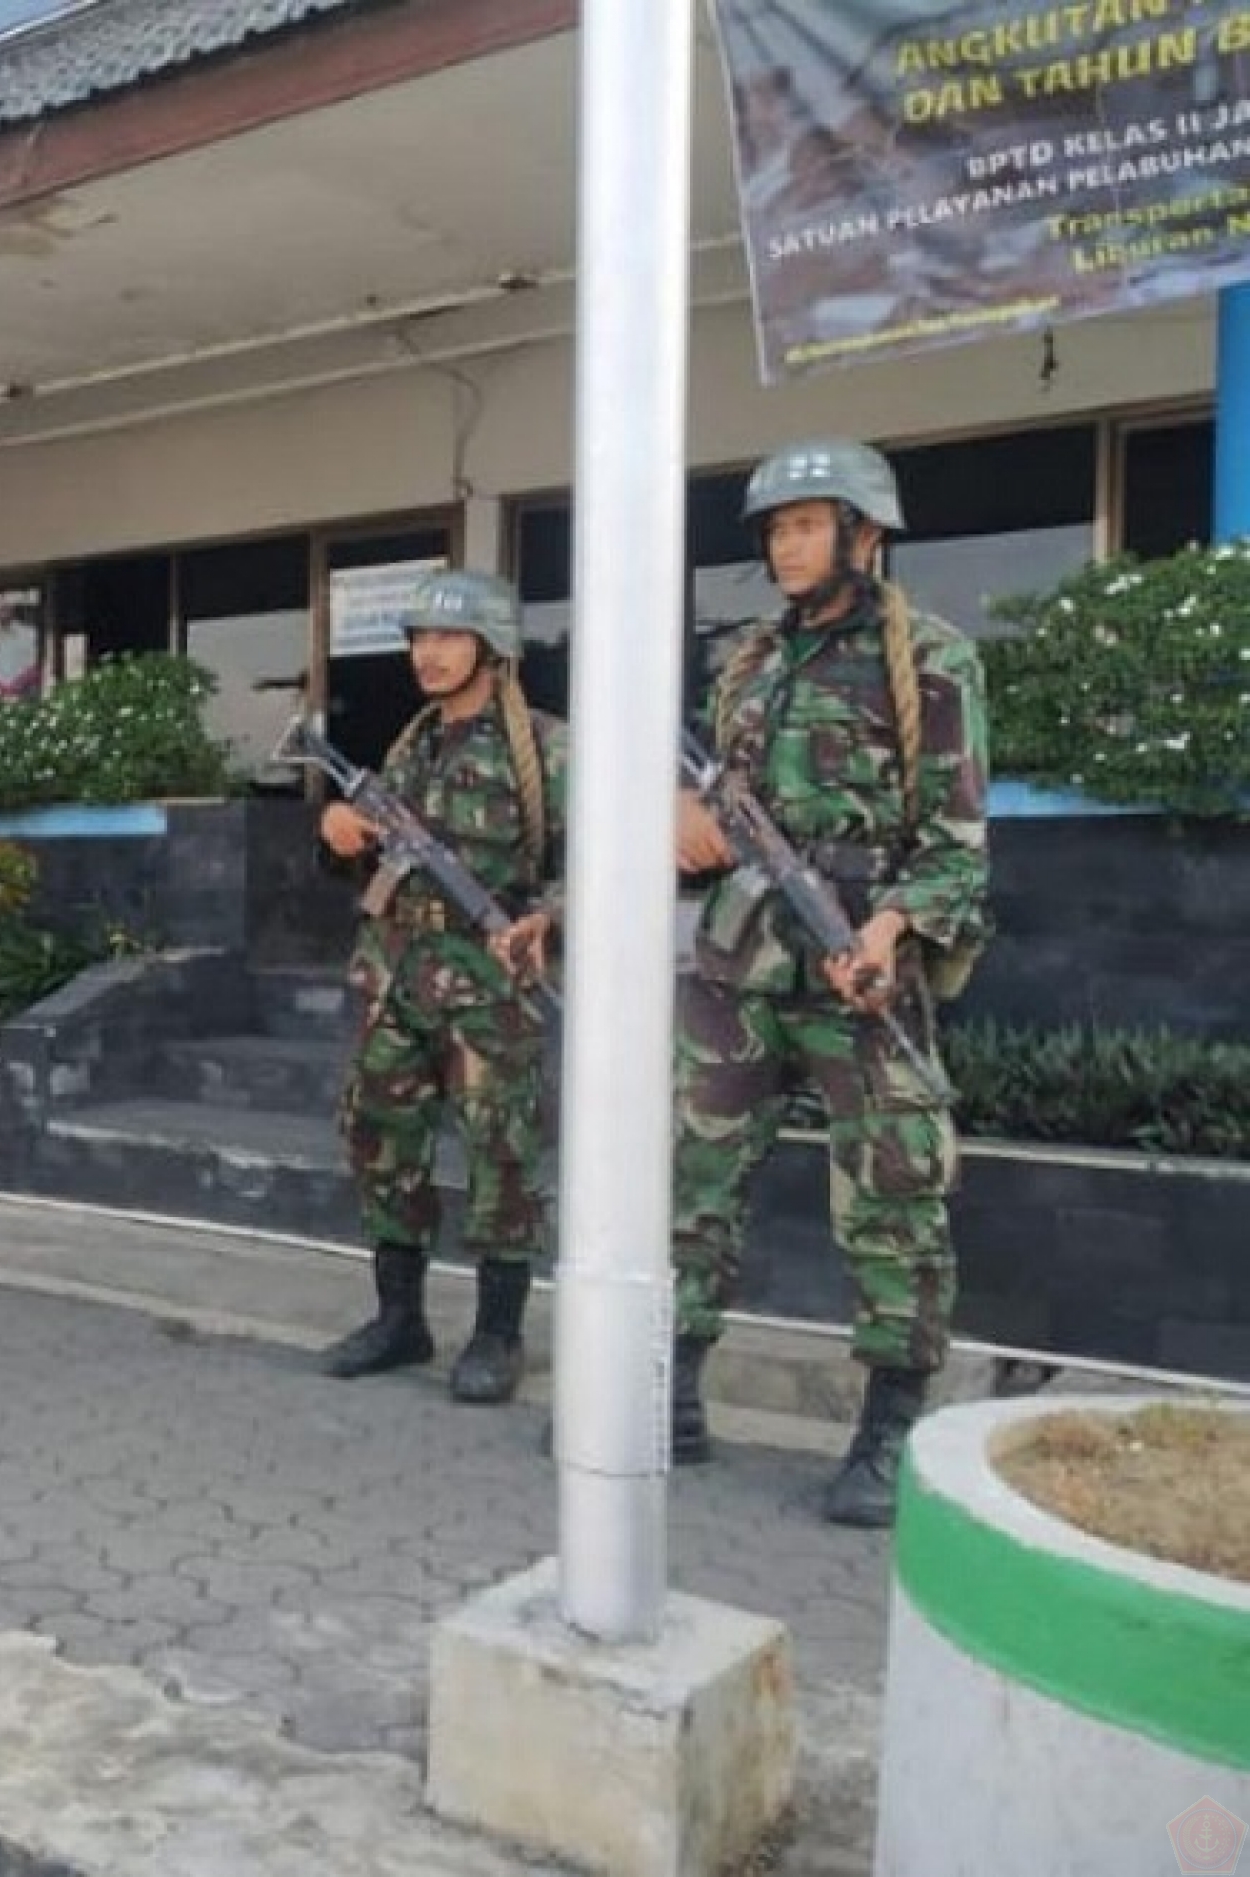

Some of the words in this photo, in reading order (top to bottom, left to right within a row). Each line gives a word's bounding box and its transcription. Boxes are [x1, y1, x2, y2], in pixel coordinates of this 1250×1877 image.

[904, 74, 1002, 123] DAN
[1012, 28, 1197, 97] TAHUN
[969, 140, 1053, 178] BPTD
[1063, 119, 1167, 158] KELAS
[769, 212, 879, 260] SATUAN
[887, 174, 1058, 232] PELAYANAN
